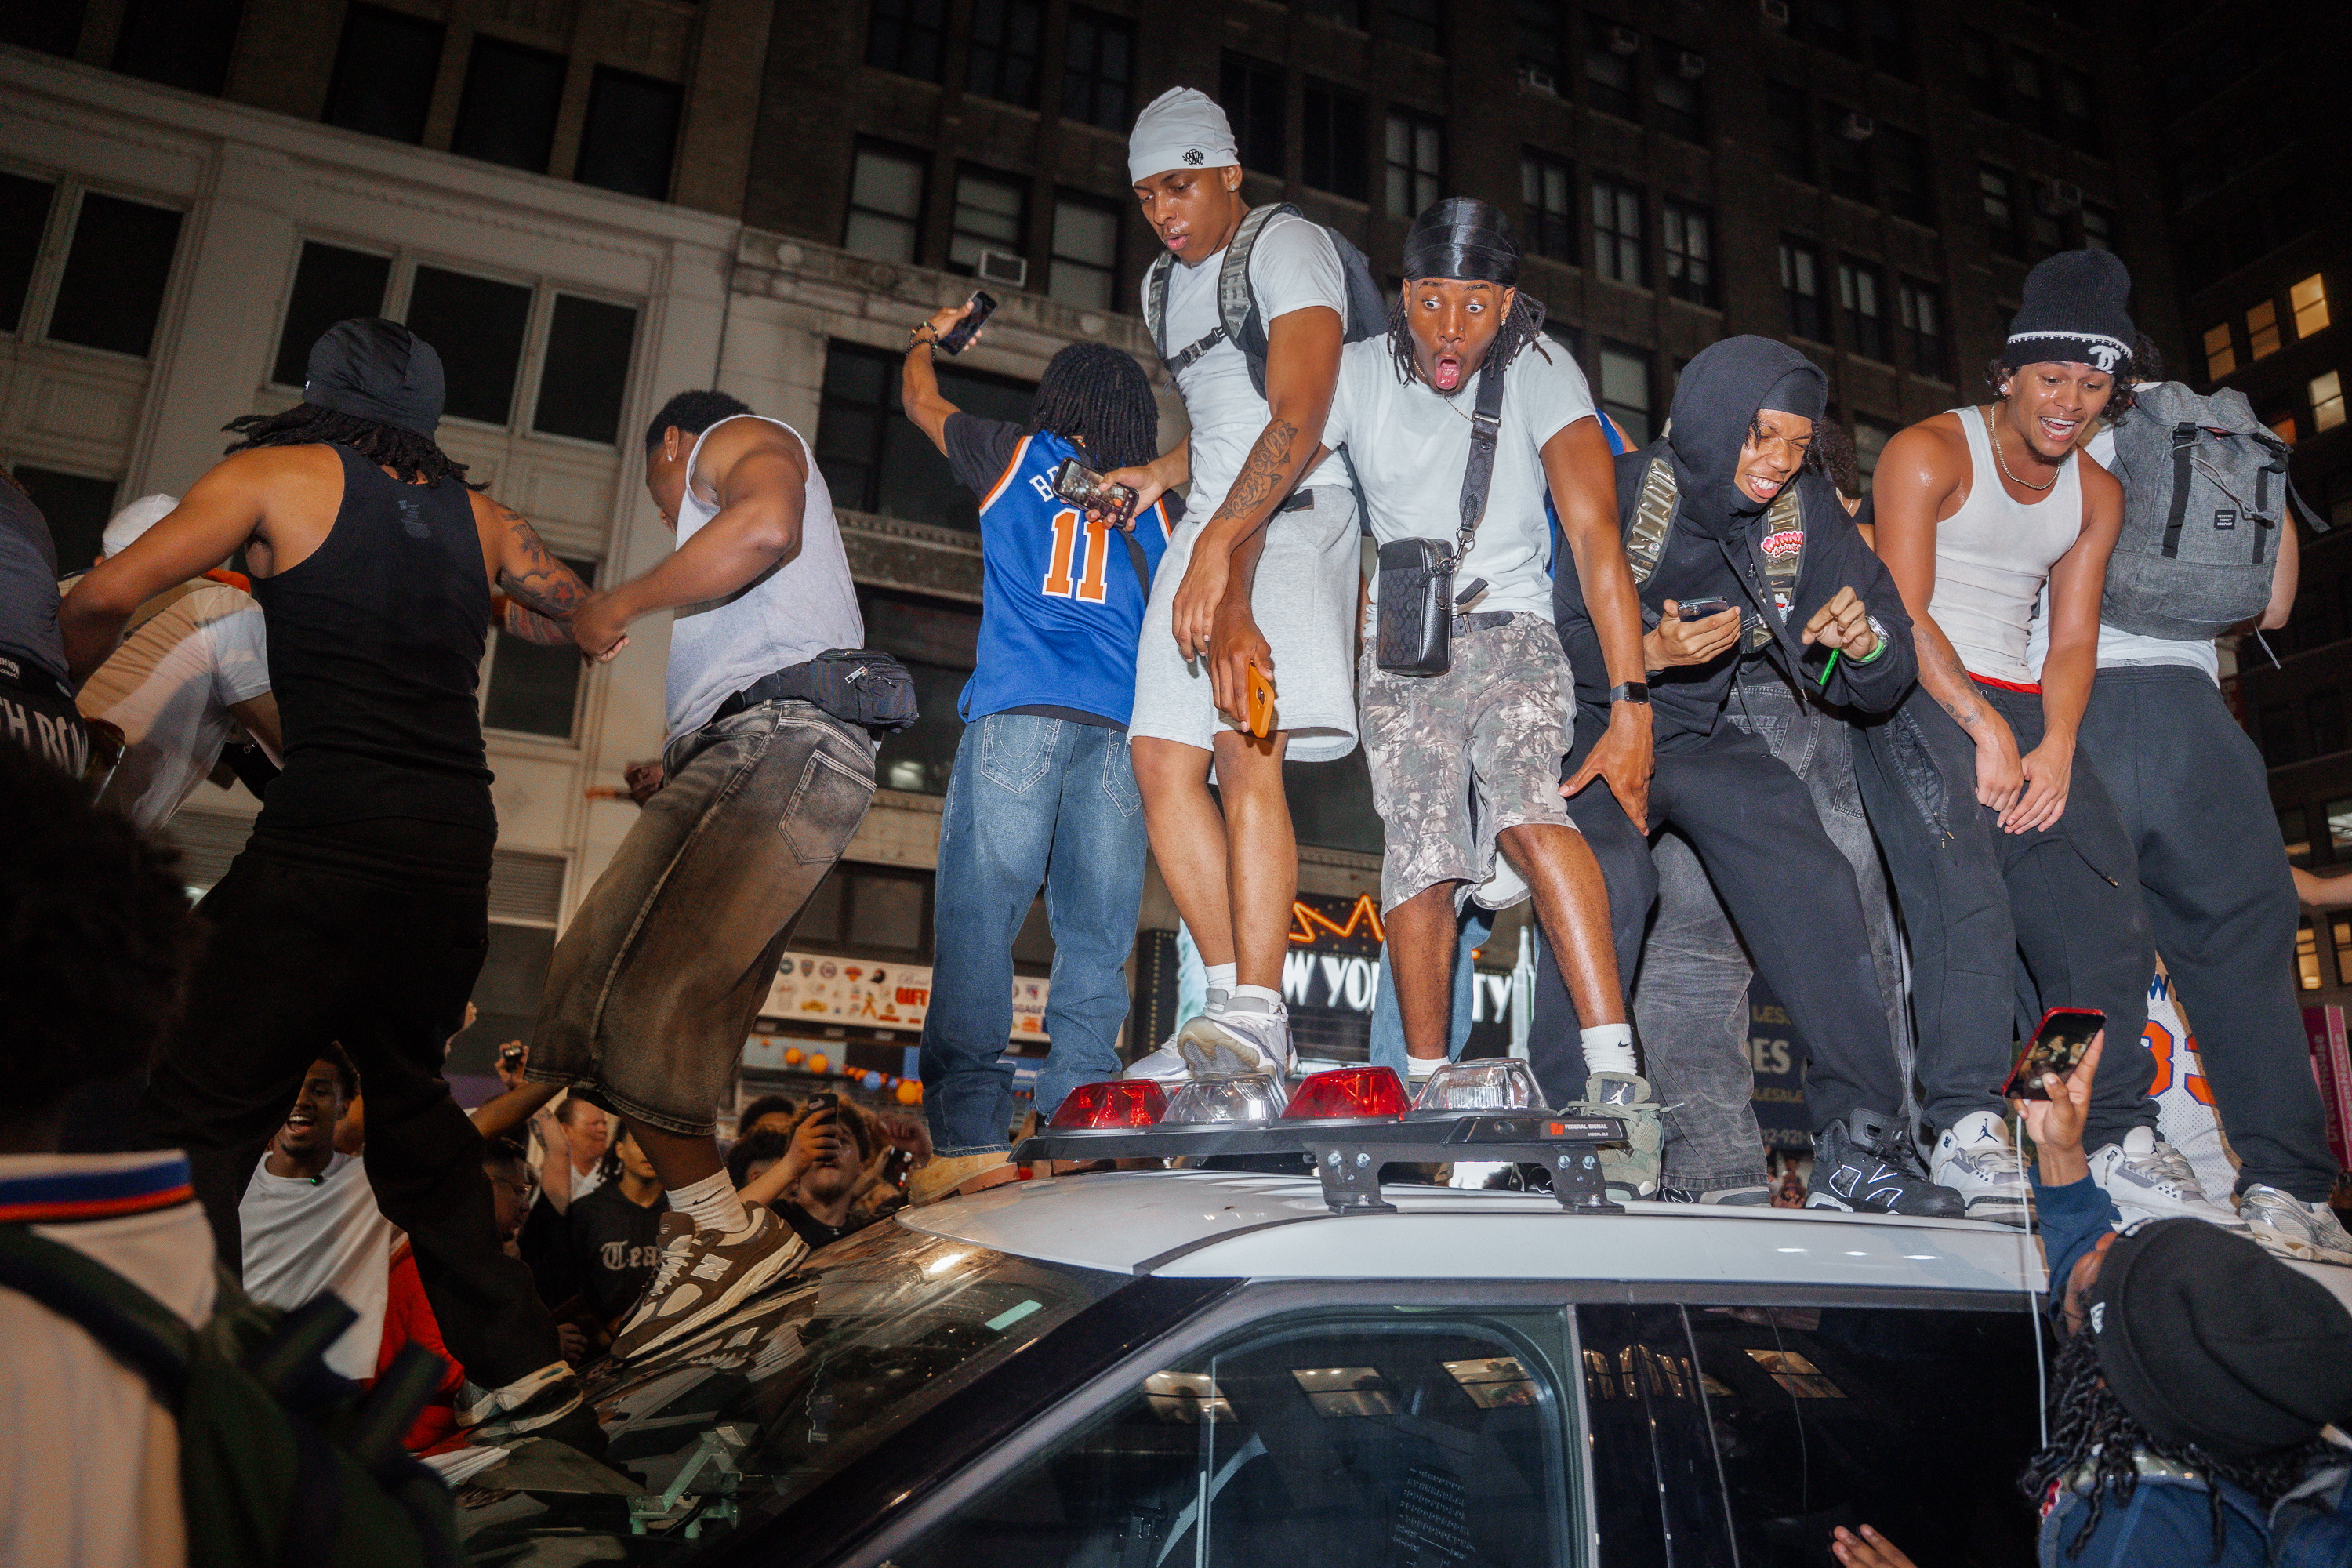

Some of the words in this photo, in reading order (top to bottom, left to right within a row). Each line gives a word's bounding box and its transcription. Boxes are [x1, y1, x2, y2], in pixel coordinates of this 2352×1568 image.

[1042, 508, 1109, 604] 11
[0, 695, 31, 751] H
[1751, 1087, 1804, 1103] LESALE
